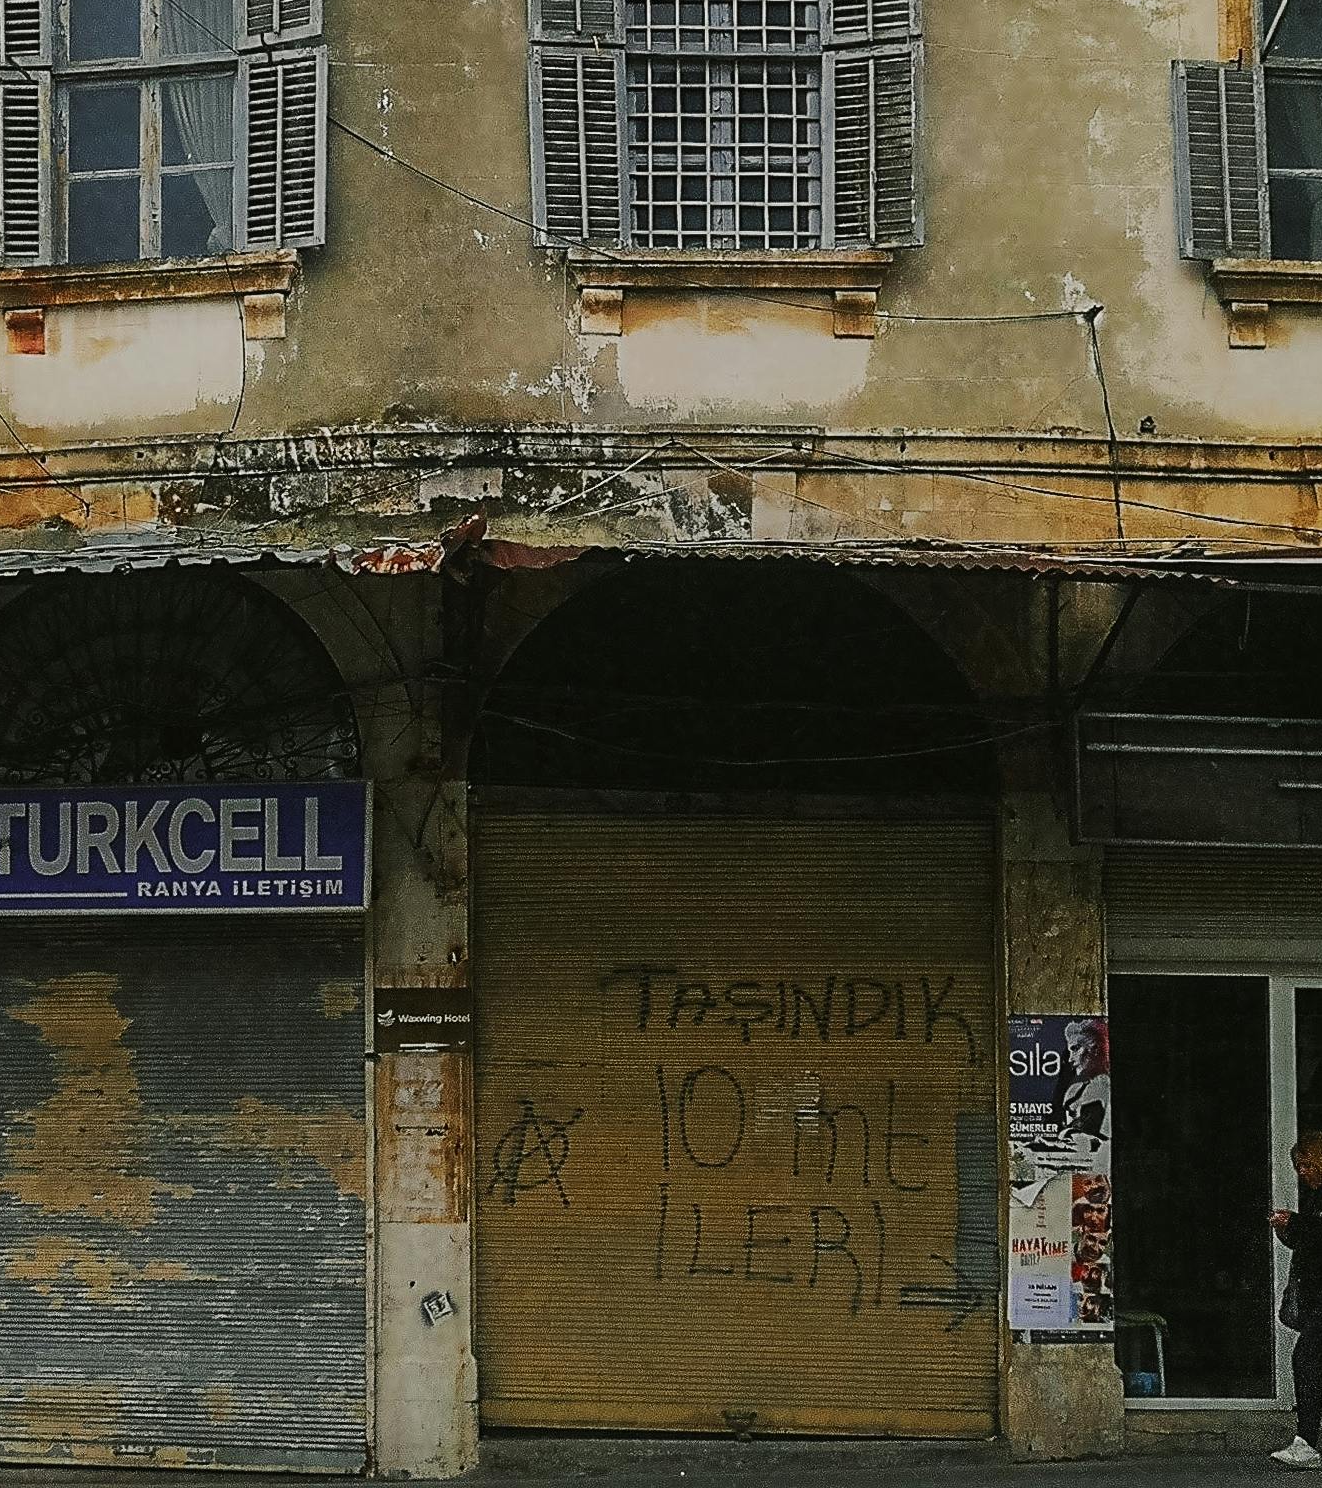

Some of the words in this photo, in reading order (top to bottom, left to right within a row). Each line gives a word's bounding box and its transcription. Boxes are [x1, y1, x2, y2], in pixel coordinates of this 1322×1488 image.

[137, 880, 222, 897] RANYA
[398, 1014, 442, 1024] Waxwing
[444, 1013, 470, 1023] Hotel
[602, 968, 980, 1066] TAŞINDIK
[1009, 1102, 1017, 1114] 5
[1018, 1102, 1053, 1114] MAYIS
[656, 1064, 746, 1172] 10
[1009, 1121, 1058, 1132] SÜMERLER
[1012, 1236, 1046, 1253] HAYAT
